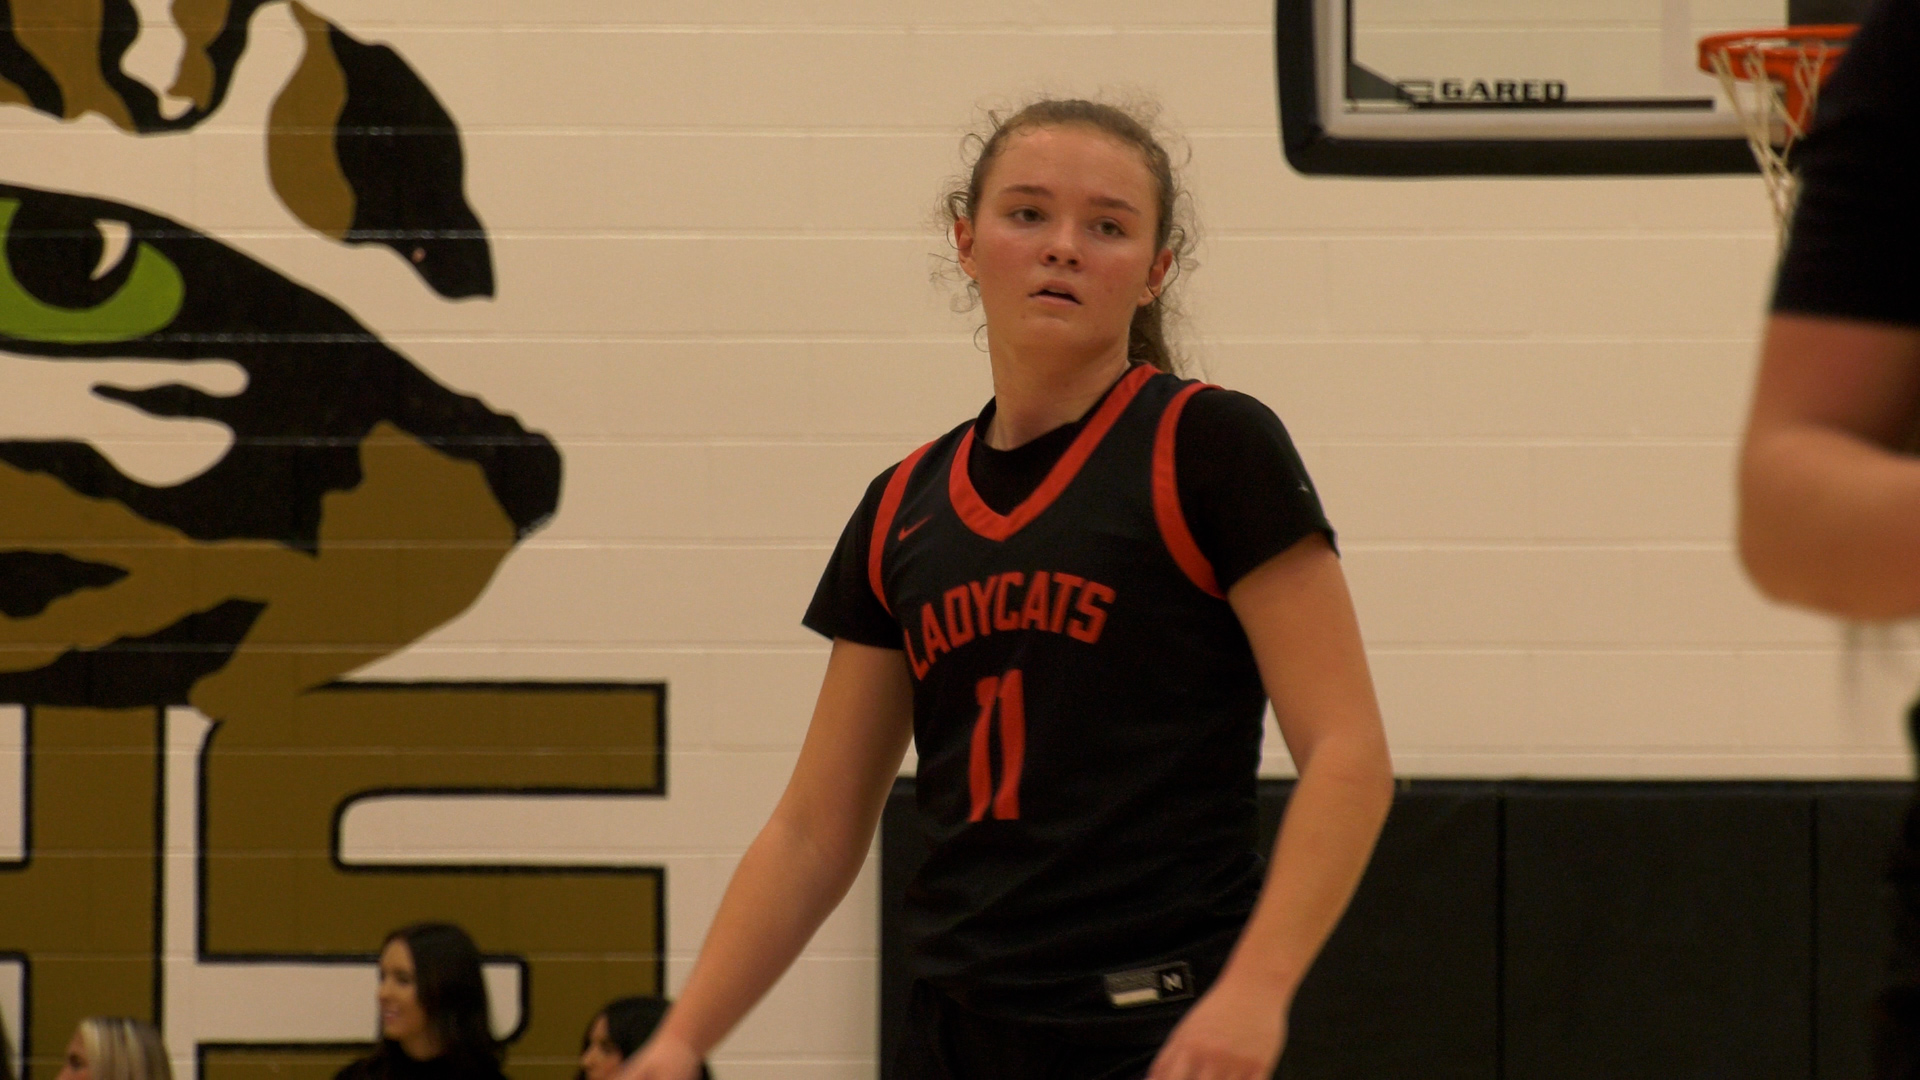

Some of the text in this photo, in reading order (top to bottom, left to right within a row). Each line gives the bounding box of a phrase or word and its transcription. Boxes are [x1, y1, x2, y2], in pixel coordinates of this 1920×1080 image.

[1441, 80, 1566, 101] GARED
[904, 571, 1117, 681] LADYCATS
[968, 669, 1027, 823] 11
